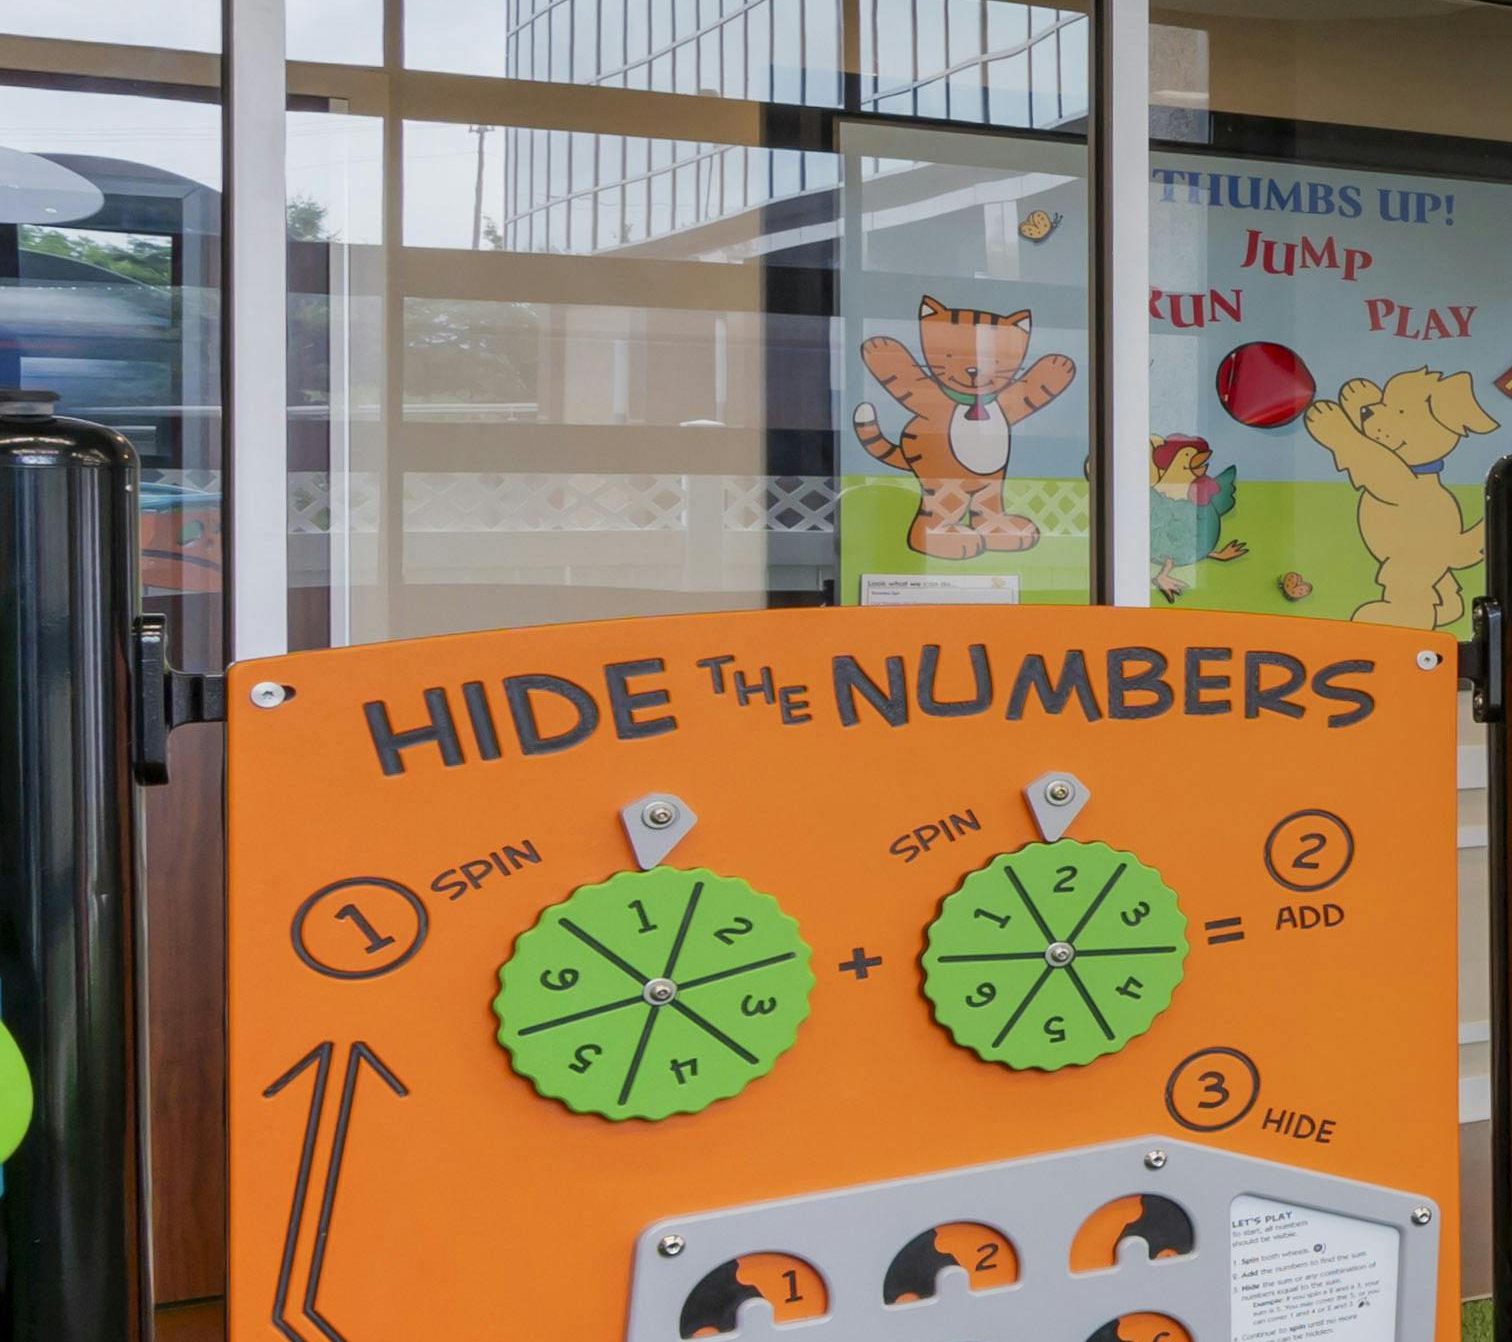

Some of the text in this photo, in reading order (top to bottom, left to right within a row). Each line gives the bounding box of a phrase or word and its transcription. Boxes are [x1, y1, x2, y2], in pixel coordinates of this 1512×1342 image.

[1153, 168, 1455, 226] THUMBS UP!
[1241, 229, 1373, 281] JUMP
[1364, 298, 1478, 340] PLAY
[364, 644, 1374, 775] HIDE THE NUMBERS
[891, 810, 980, 861] SPIN
[1293, 834, 1326, 869] 2
[1053, 866, 1077, 892] 2
[336, 841, 540, 953] 1 SPIN
[628, 900, 657, 933] 1
[974, 909, 1011, 928] 1
[1121, 902, 1150, 926] 3
[1278, 904, 1343, 929] ADD
[714, 917, 753, 944] 2
[541, 969, 579, 990] 6
[1115, 976, 1143, 999] 4
[742, 995, 776, 1016] 3
[966, 983, 996, 1007] 6
[1044, 1016, 1065, 1043] 5
[569, 1044, 602, 1073] 5
[670, 1058, 697, 1084] 4
[1199, 1072, 1228, 1108] 3
[1263, 1109, 1335, 1142] HIDE
[1232, 1211, 1292, 1230] LET'S PLAY
[1275, 1220, 1309, 1231] numbers
[1232, 1237, 1258, 1248] should
[976, 1244, 998, 1271] 2
[1242, 1257, 1259, 1266] Spin
[1261, 1252, 1280, 1261] both
[1242, 1270, 1258, 1279] Add
[1275, 1262, 1307, 1273] numbers
[783, 1271, 801, 1302] 1
[1242, 1284, 1259, 1292] Hide
[1320, 1265, 1367, 1277] combination
[1242, 1291, 1276, 1302] numbers
[1242, 1330, 1276, 1341] Continue
[1290, 1324, 1306, 1332] spin
